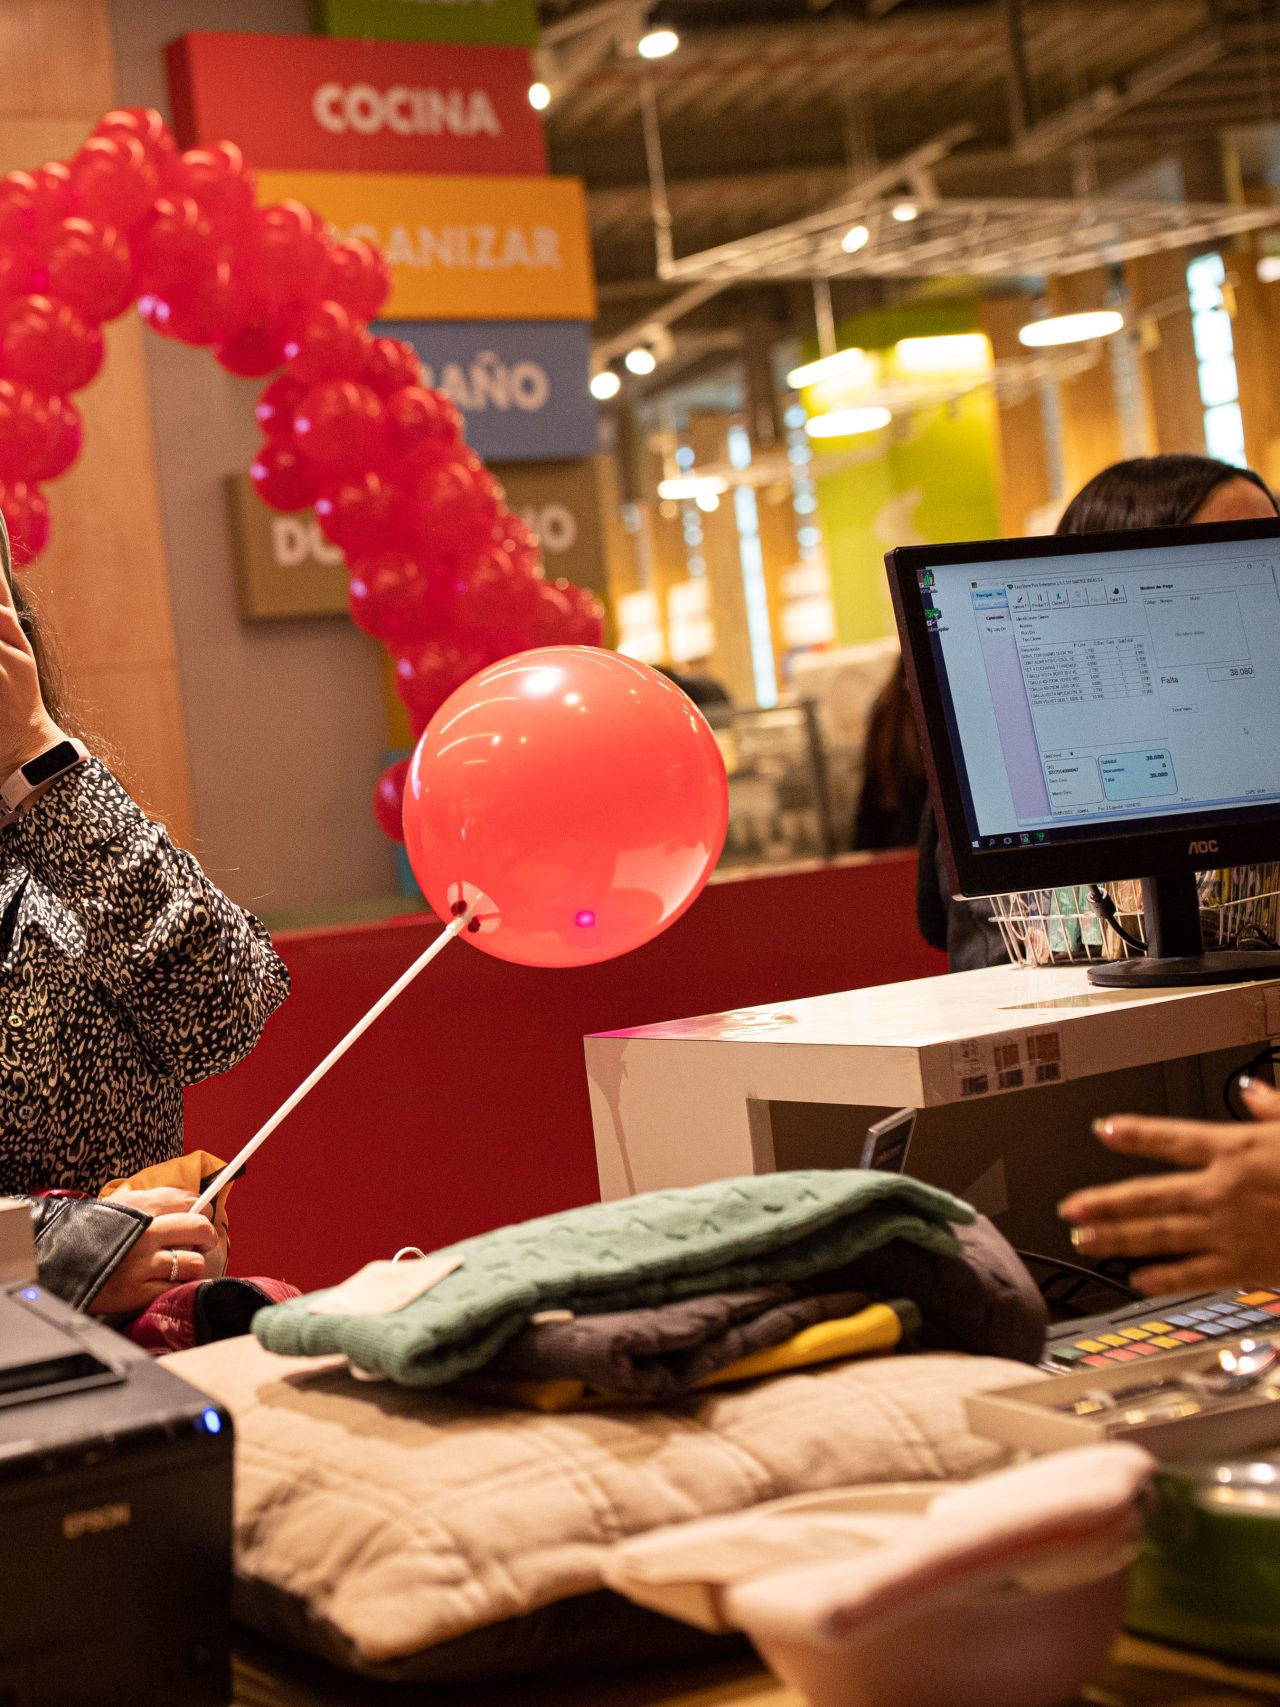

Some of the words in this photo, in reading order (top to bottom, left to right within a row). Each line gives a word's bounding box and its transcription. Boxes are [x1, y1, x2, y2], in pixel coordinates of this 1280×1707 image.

[312, 82, 501, 137] COCINA
[342, 222, 561, 270] ANIZAR
[1161, 676, 1179, 684] Falta
[1188, 839, 1219, 855] AOC
